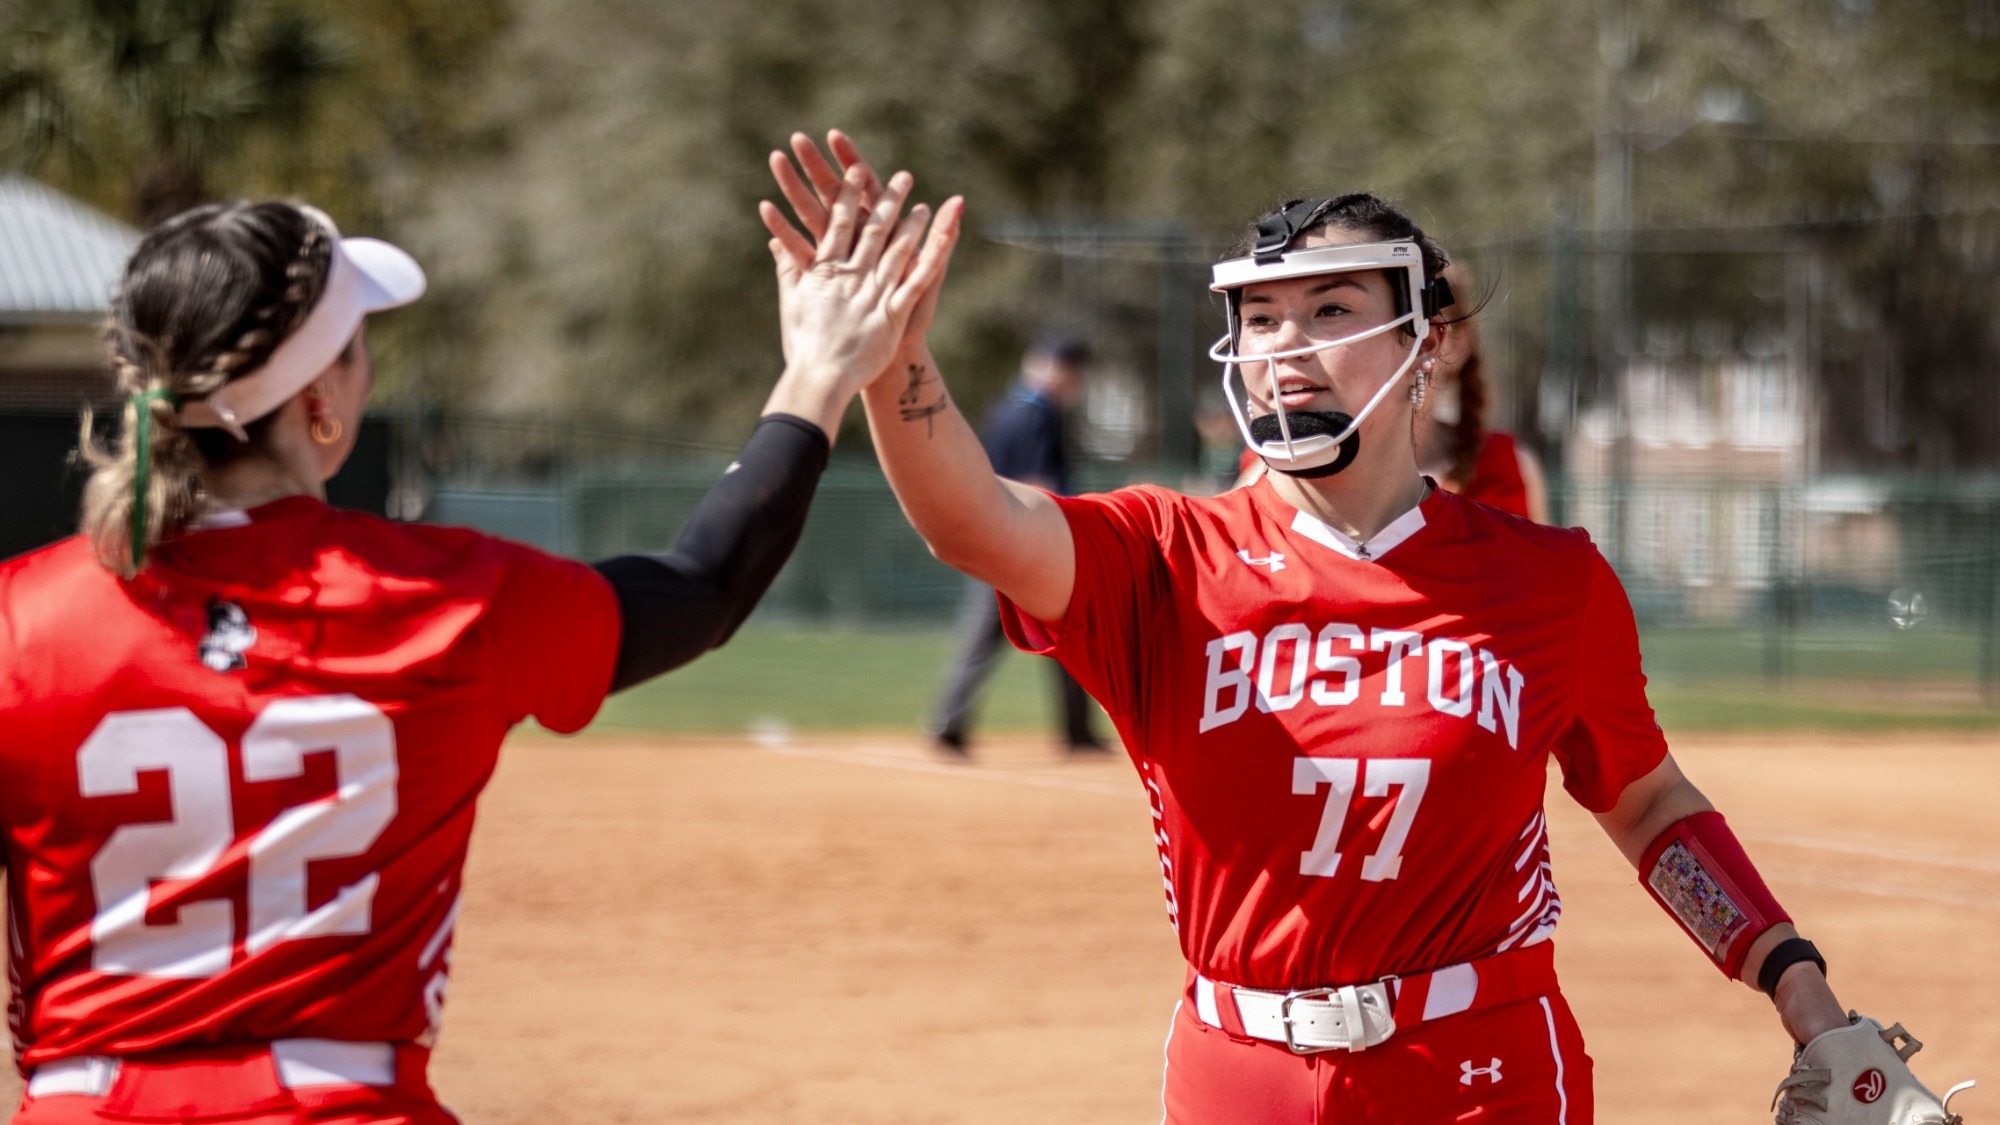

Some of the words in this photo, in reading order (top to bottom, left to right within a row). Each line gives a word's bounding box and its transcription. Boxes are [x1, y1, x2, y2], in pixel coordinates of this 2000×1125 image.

[1199, 622, 1524, 751] BOSTON
[76, 693, 400, 978] 22
[1291, 756, 1432, 882] 77
[1854, 1070, 1883, 1102] R
